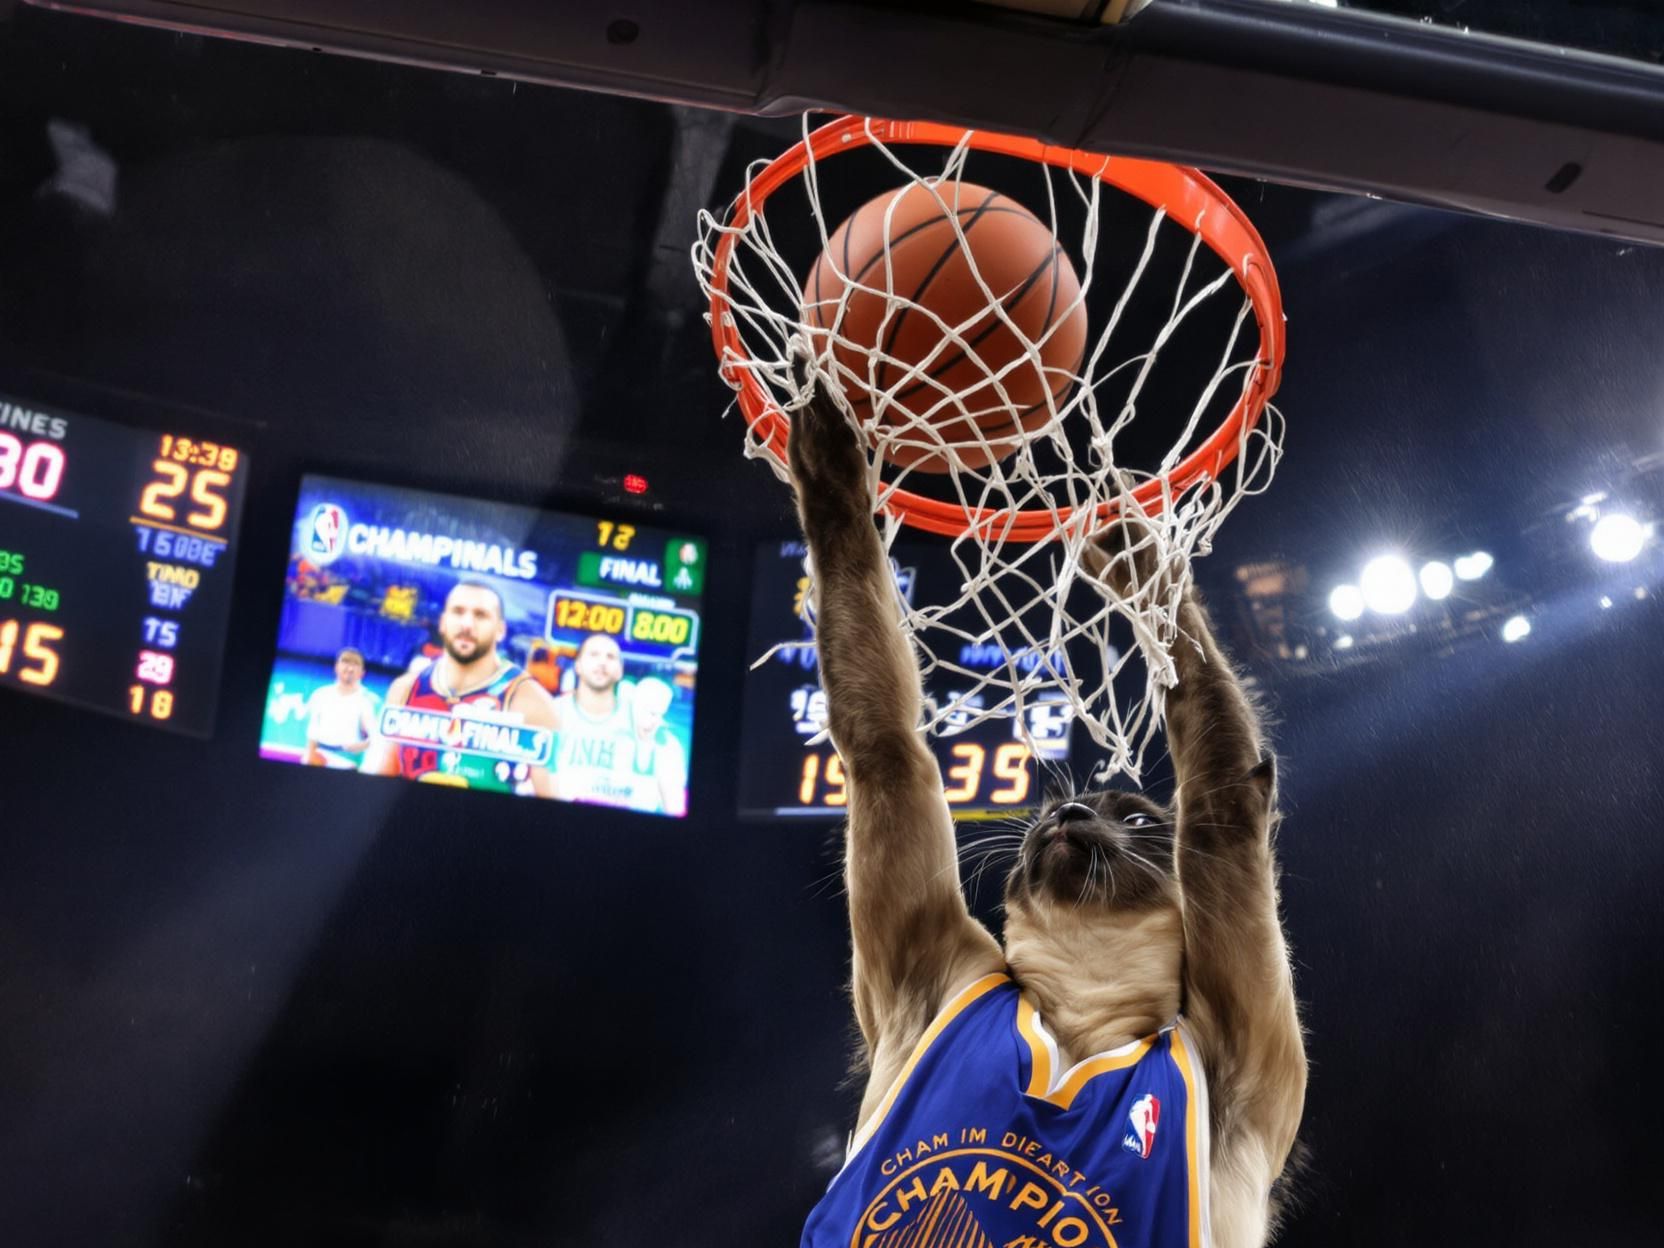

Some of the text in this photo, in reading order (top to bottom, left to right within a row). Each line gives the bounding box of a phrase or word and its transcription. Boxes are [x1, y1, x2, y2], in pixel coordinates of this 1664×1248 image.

[0, 402, 67, 440] INES
[141, 460, 232, 529] 25
[348, 522, 538, 580] CHAMPINALS
[600, 556, 662, 588] FINAL
[556, 599, 625, 634] 12:00
[880, 1132, 949, 1175] CHAM
[960, 1127, 987, 1144] IM
